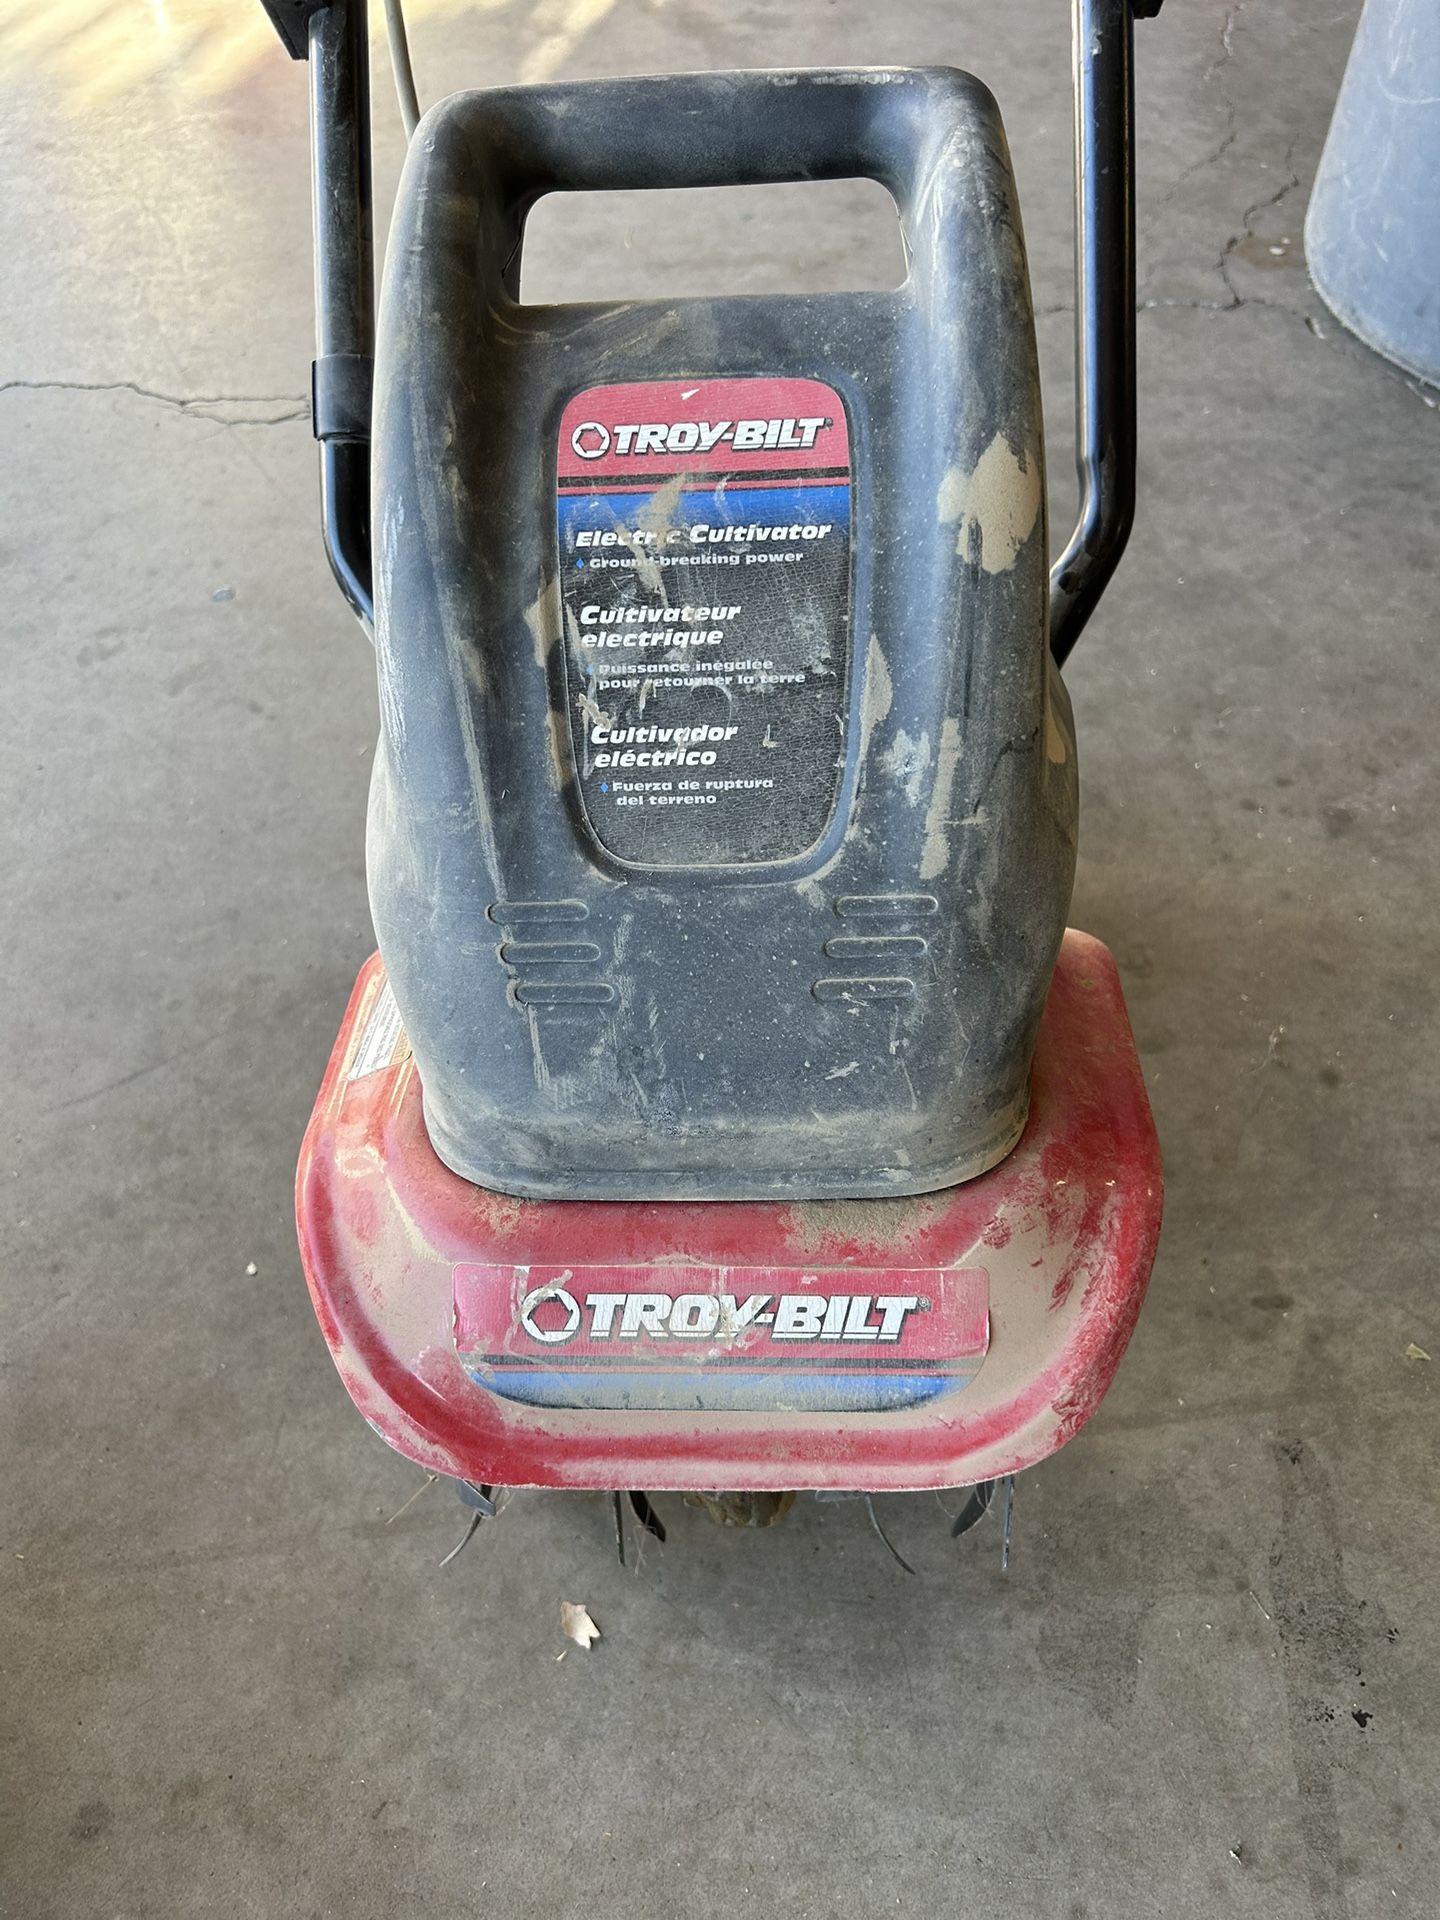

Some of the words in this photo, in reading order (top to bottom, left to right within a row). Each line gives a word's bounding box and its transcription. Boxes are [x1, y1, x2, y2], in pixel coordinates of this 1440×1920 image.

[613, 417, 825, 455] TROY-BILT
[575, 528, 682, 548] Electrc
[689, 523, 832, 544] Cultivator
[589, 552, 740, 569] Groun-breaking
[746, 551, 804, 565] power
[580, 605, 742, 625] Cultivateur
[581, 628, 724, 648] electrique
[599, 678, 640, 690] pour
[737, 674, 754, 685] la
[760, 673, 806, 685] terre
[591, 724, 739, 744] Cultivador
[594, 748, 718, 768] eléctrico
[612, 780, 673, 792] Fuerza
[678, 778, 700, 791] de
[705, 777, 774, 790] ruptura
[616, 795, 644, 807] del
[649, 793, 717, 806] terreno
[585, 1292, 919, 1342] TROY-BILT
